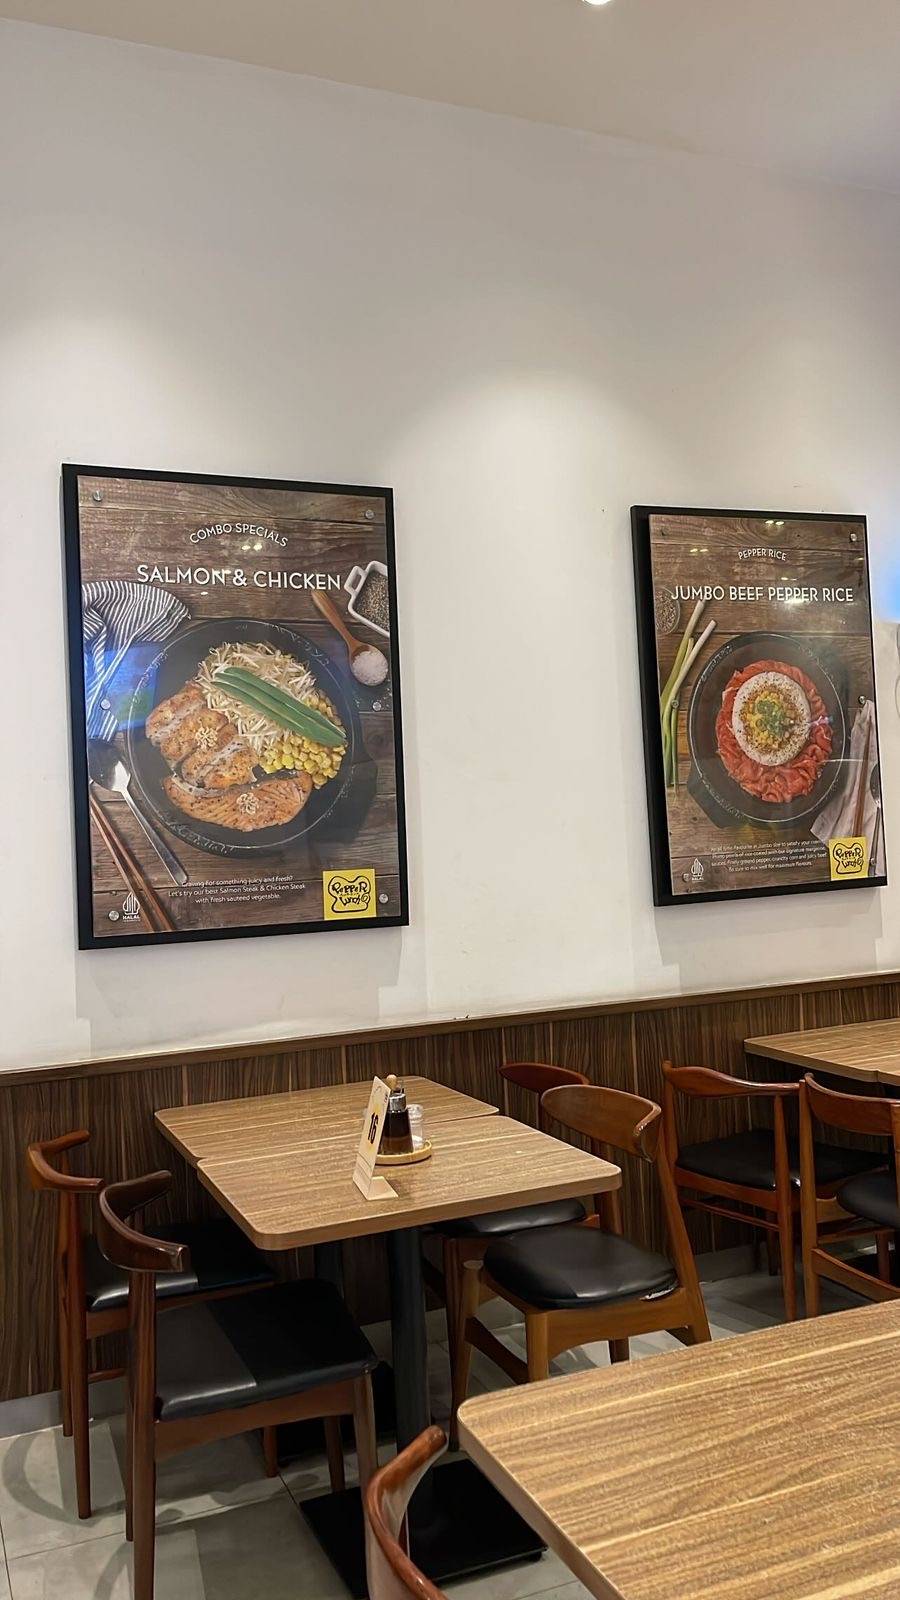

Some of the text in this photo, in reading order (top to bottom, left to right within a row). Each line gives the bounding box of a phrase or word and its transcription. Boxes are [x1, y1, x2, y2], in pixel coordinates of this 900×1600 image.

[190, 523, 288, 547] COMBO SPECIALS
[738, 548, 786, 561] PEPPER RICE
[137, 564, 340, 590] SALMON & CHICKEN
[672, 586, 854, 602] JUMBO BEEF PEPPER RICE
[368, 1112, 378, 1144] 16
